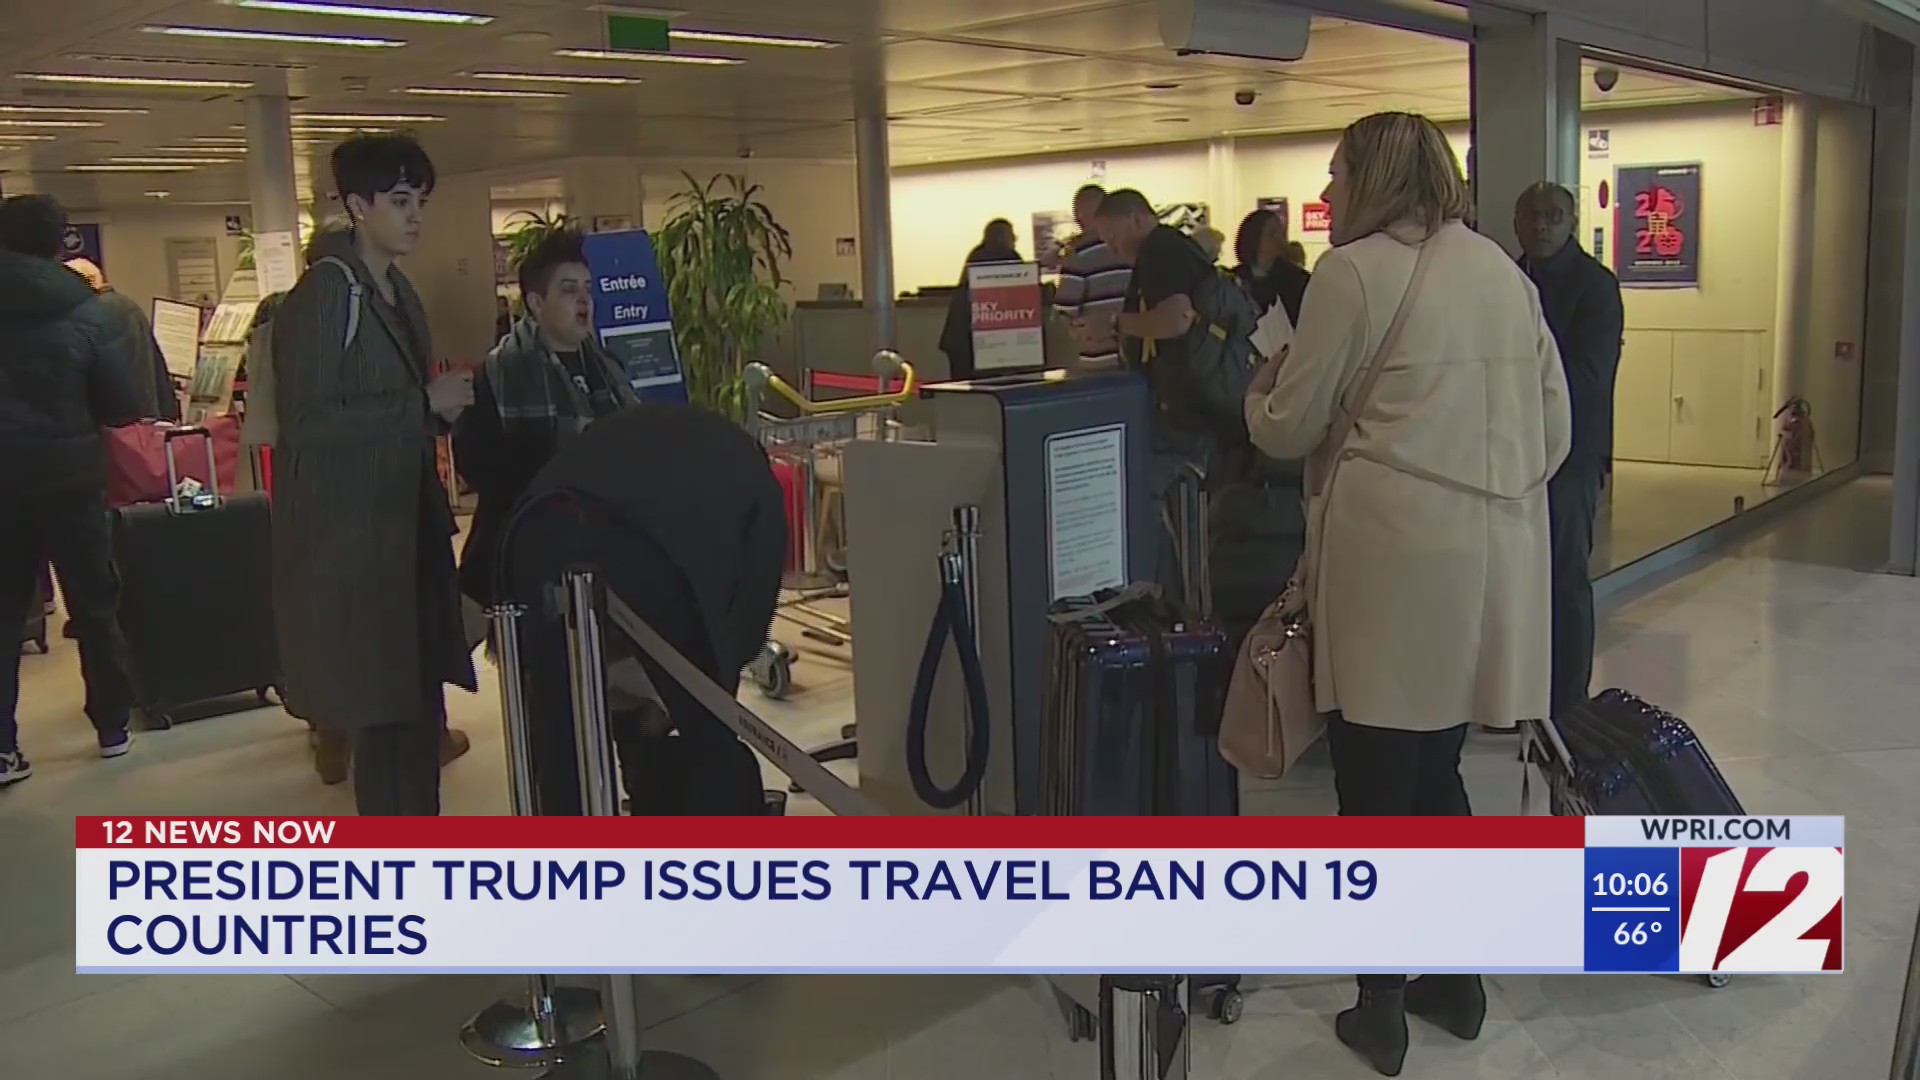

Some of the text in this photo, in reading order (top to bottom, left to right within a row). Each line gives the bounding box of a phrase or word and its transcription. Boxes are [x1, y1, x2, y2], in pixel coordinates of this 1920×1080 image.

[600, 274, 647, 292] Entrée
[614, 305, 648, 319] Entry
[971, 308, 1035, 322] PRIORITY
